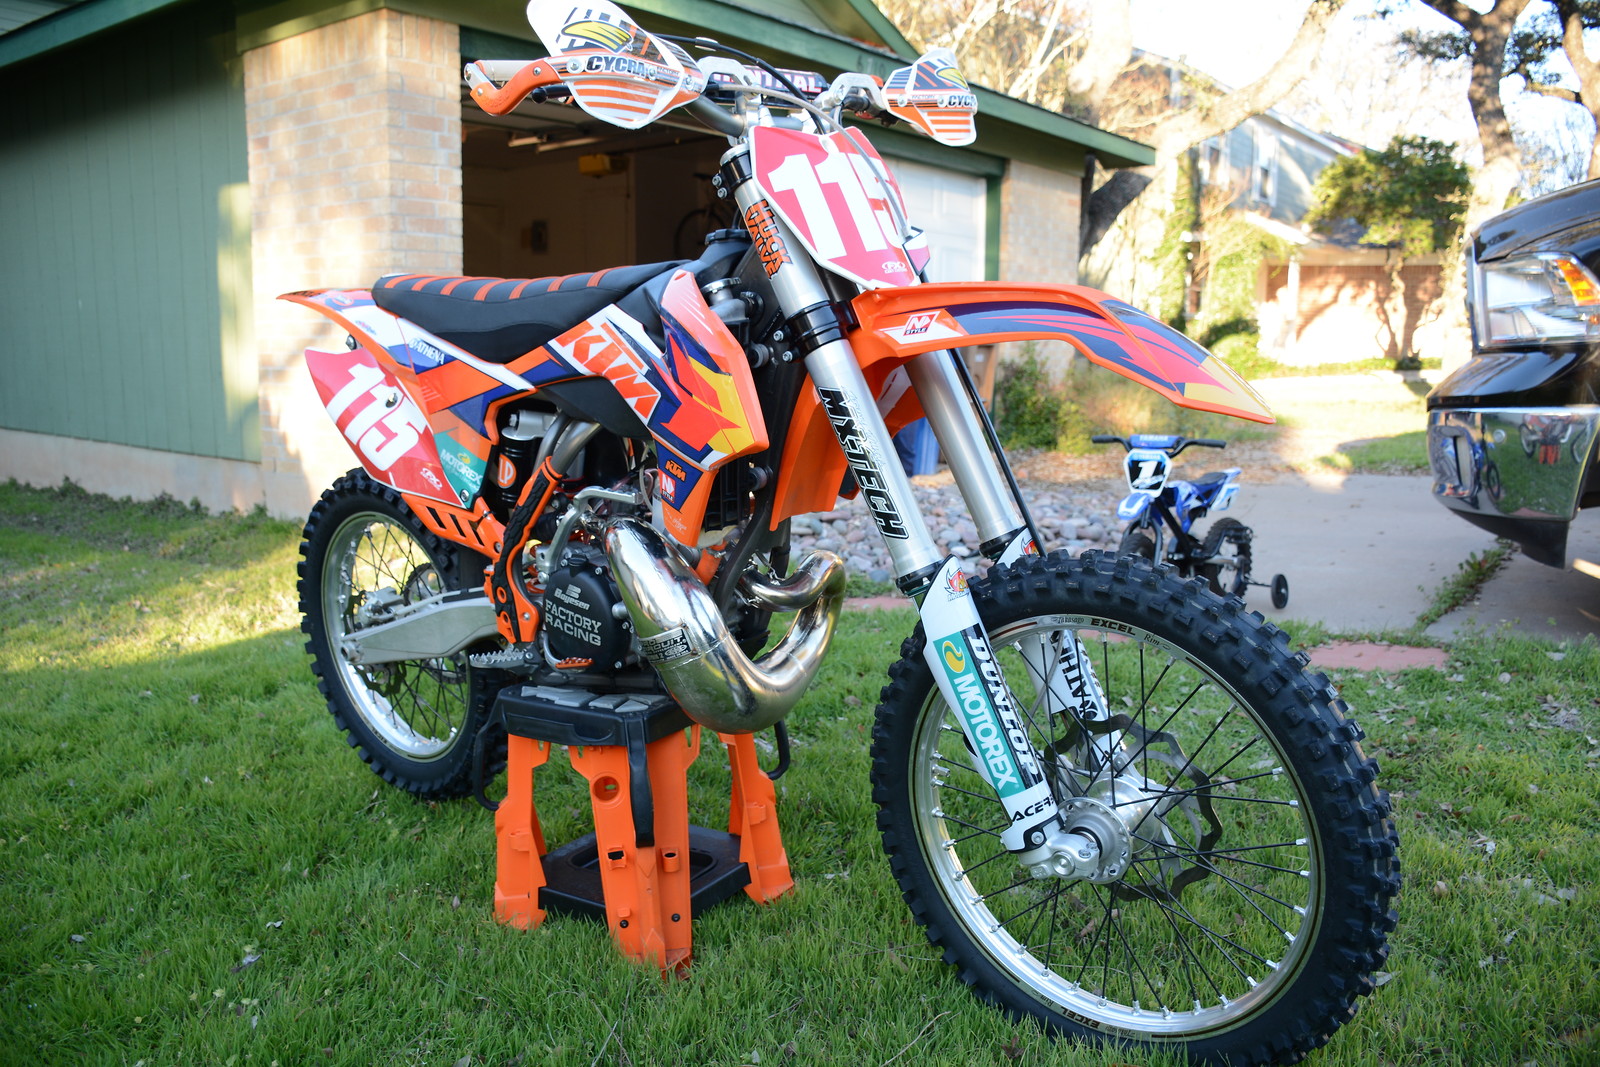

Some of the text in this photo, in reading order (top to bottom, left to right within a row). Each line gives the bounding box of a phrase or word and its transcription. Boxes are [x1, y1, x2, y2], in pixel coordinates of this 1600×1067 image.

[905, 327, 927, 335] STYLE
[414, 340, 446, 365] ATHENA
[554, 319, 661, 420] KTM
[326, 362, 428, 472] 115
[441, 449, 484, 485] MOTOREX
[665, 460, 687, 482] KTM
[545, 598, 602, 634] FACTORY
[545, 611, 602, 647] RACING
[1090, 618, 1136, 636] EXCEL
[967, 635, 1039, 778] DUNLOP
[954, 672, 1018, 794] MOTOREX
[1060, 1006, 1100, 1029] EXCEL
